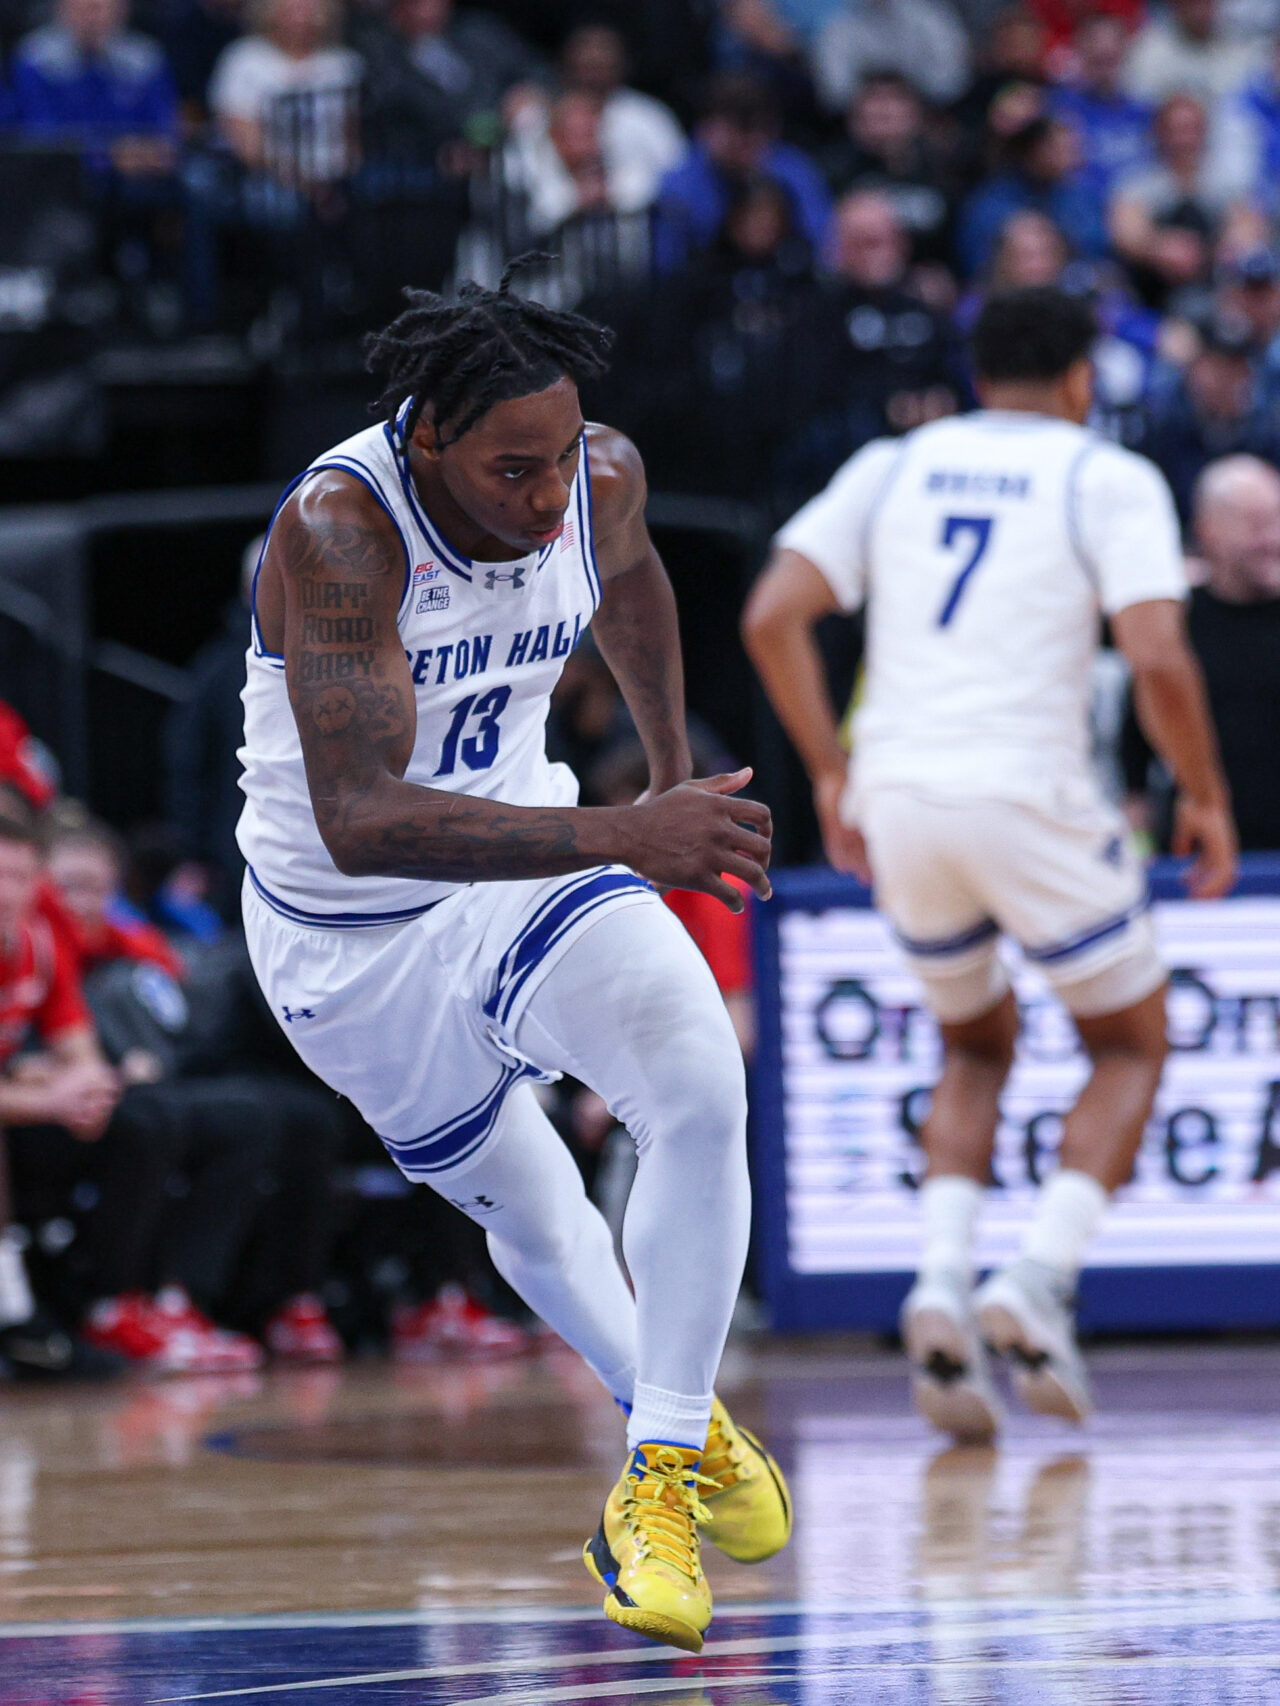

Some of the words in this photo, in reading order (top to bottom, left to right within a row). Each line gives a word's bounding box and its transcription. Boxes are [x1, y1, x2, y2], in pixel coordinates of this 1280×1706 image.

[413, 569, 440, 583] EAST
[937, 515, 996, 630] 7
[416, 598, 450, 614] CHANGE
[431, 586, 450, 600] THE
[405, 634, 493, 685] ETON
[432, 685, 513, 777] 13
